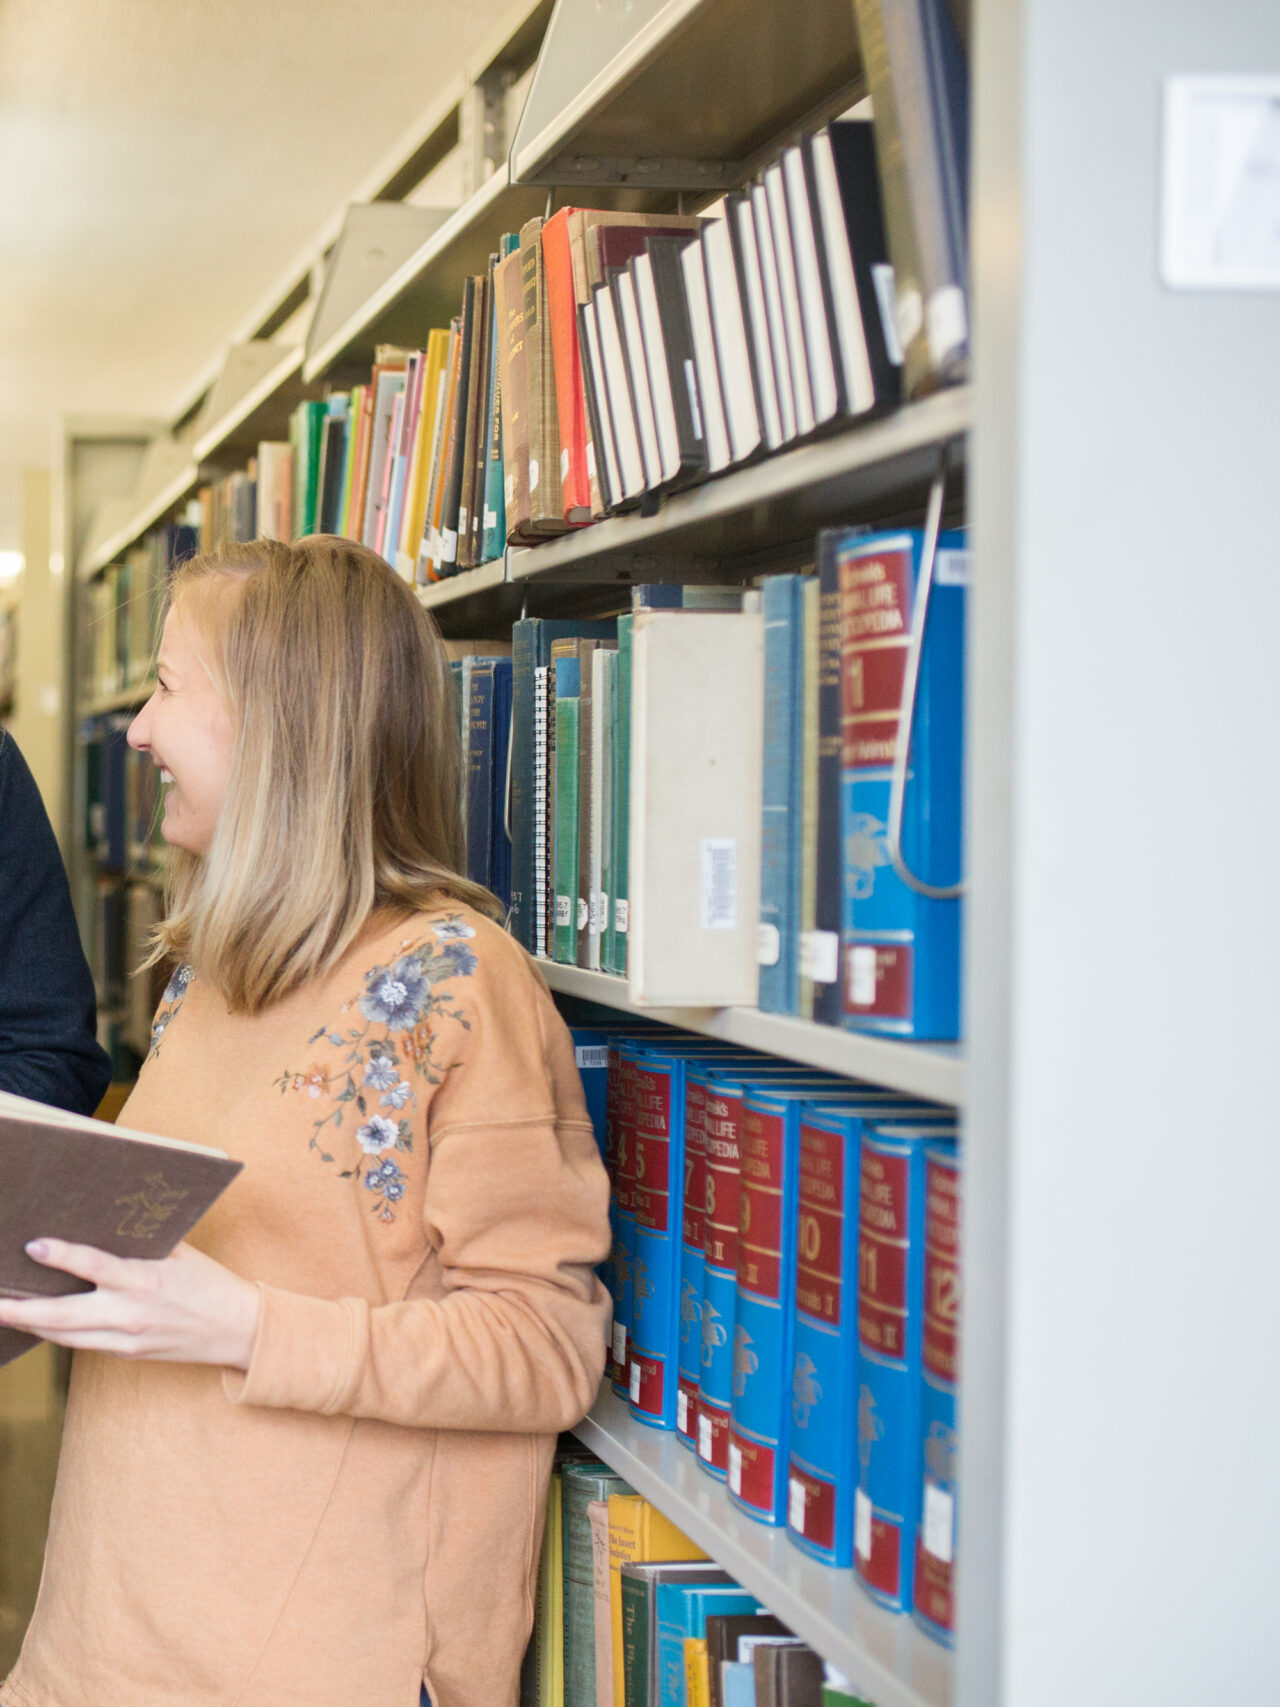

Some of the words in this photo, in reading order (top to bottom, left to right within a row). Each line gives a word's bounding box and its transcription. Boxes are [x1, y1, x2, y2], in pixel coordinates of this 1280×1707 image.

[493, 416, 501, 441] FOR
[717, 1120, 737, 1140] LIFE
[618, 1132, 628, 1167] 4
[636, 1142, 646, 1179] 5
[685, 1158, 695, 1196] 7
[706, 1175, 716, 1215] 8
[714, 1241, 724, 1261] II
[800, 1214, 820, 1261] 10
[609, 1532, 618, 1546] The
[618, 1534, 636, 1550] Insect
[626, 1603, 636, 1637] The
